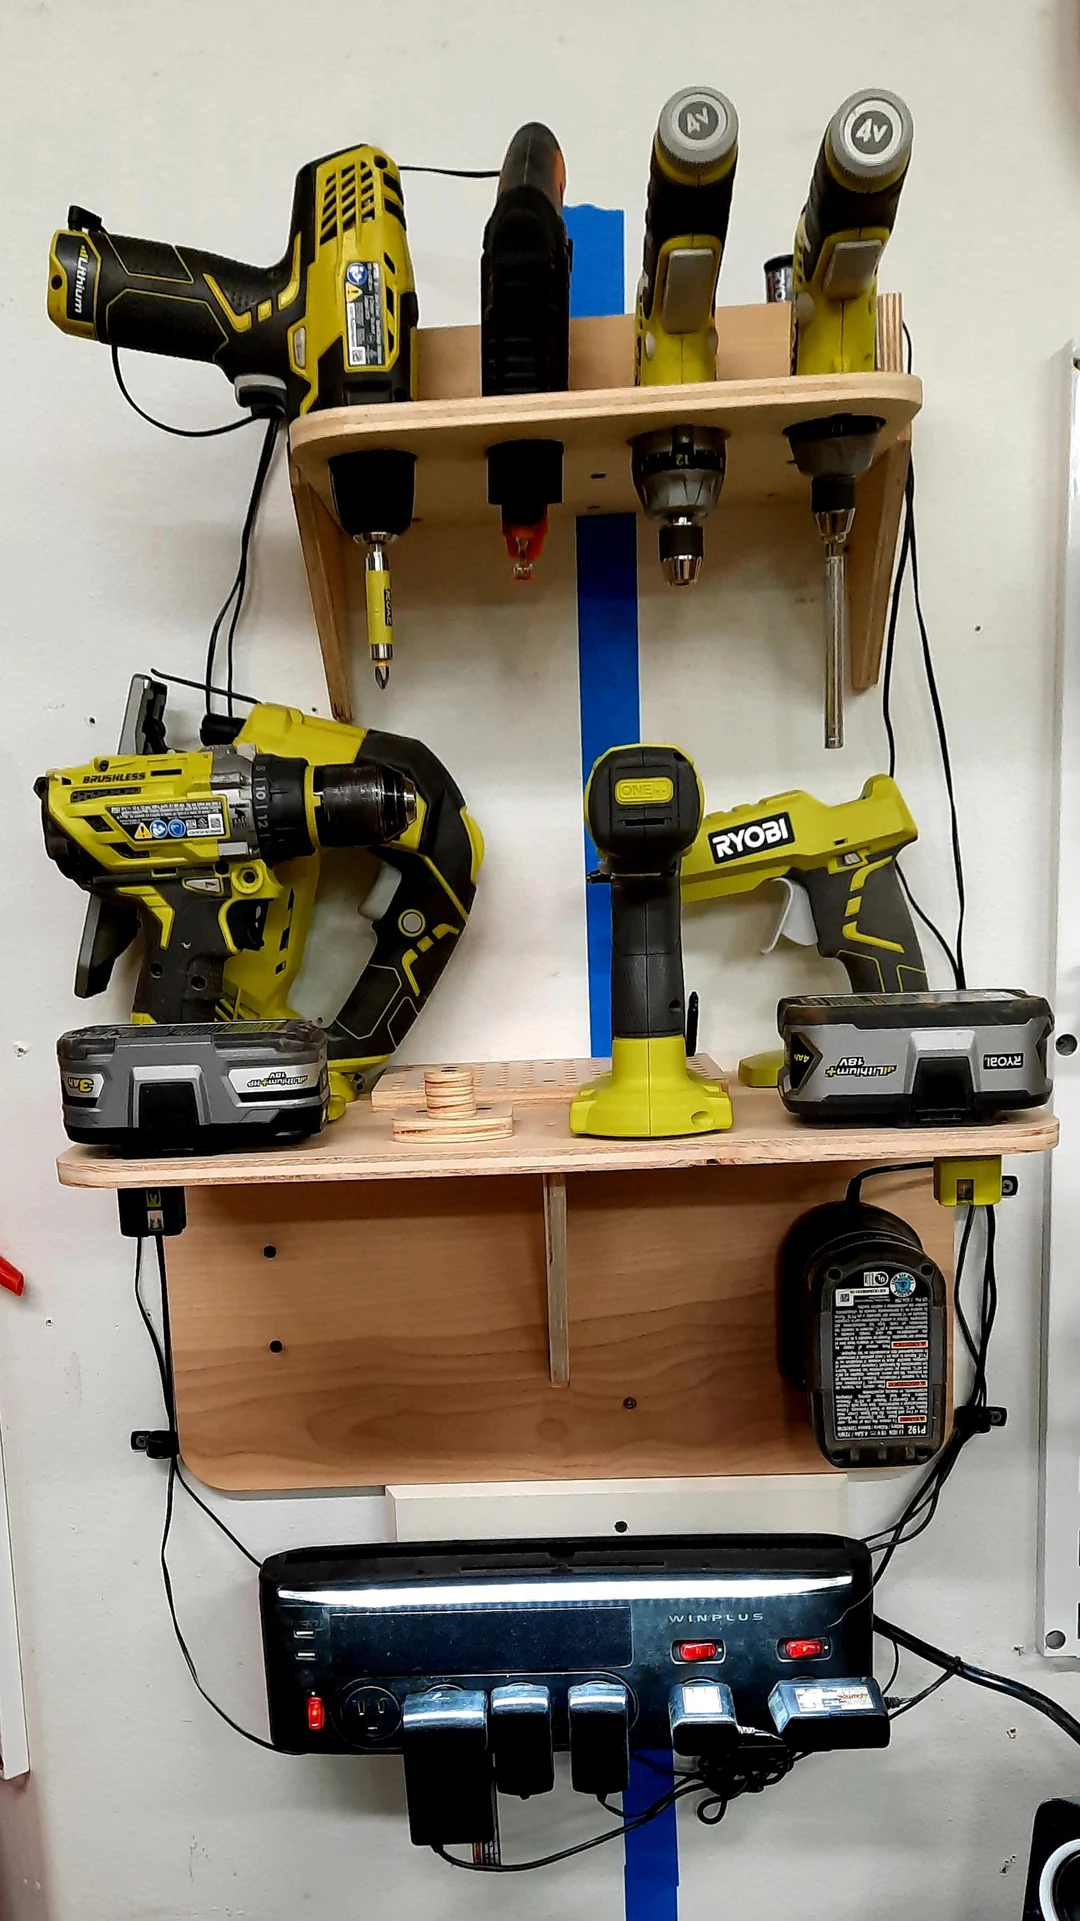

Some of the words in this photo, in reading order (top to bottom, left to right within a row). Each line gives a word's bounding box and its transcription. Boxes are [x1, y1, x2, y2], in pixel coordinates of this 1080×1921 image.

[75, 257, 88, 314] Lithium
[676, 454, 690, 466] 12
[82, 772, 146, 784] BRUSHLESS
[255, 786, 267, 800] 10
[257, 814, 269, 829] 12
[712, 817, 789, 858] RYOBI
[839, 1057, 864, 1066] 18V
[985, 1055, 1022, 1067] RYOBI
[827, 1066, 886, 1077] Lithium+
[69, 1078, 94, 1092] 3Ah
[907, 1425, 927, 1435] P192
[668, 1612, 763, 1623] WINPLUS
